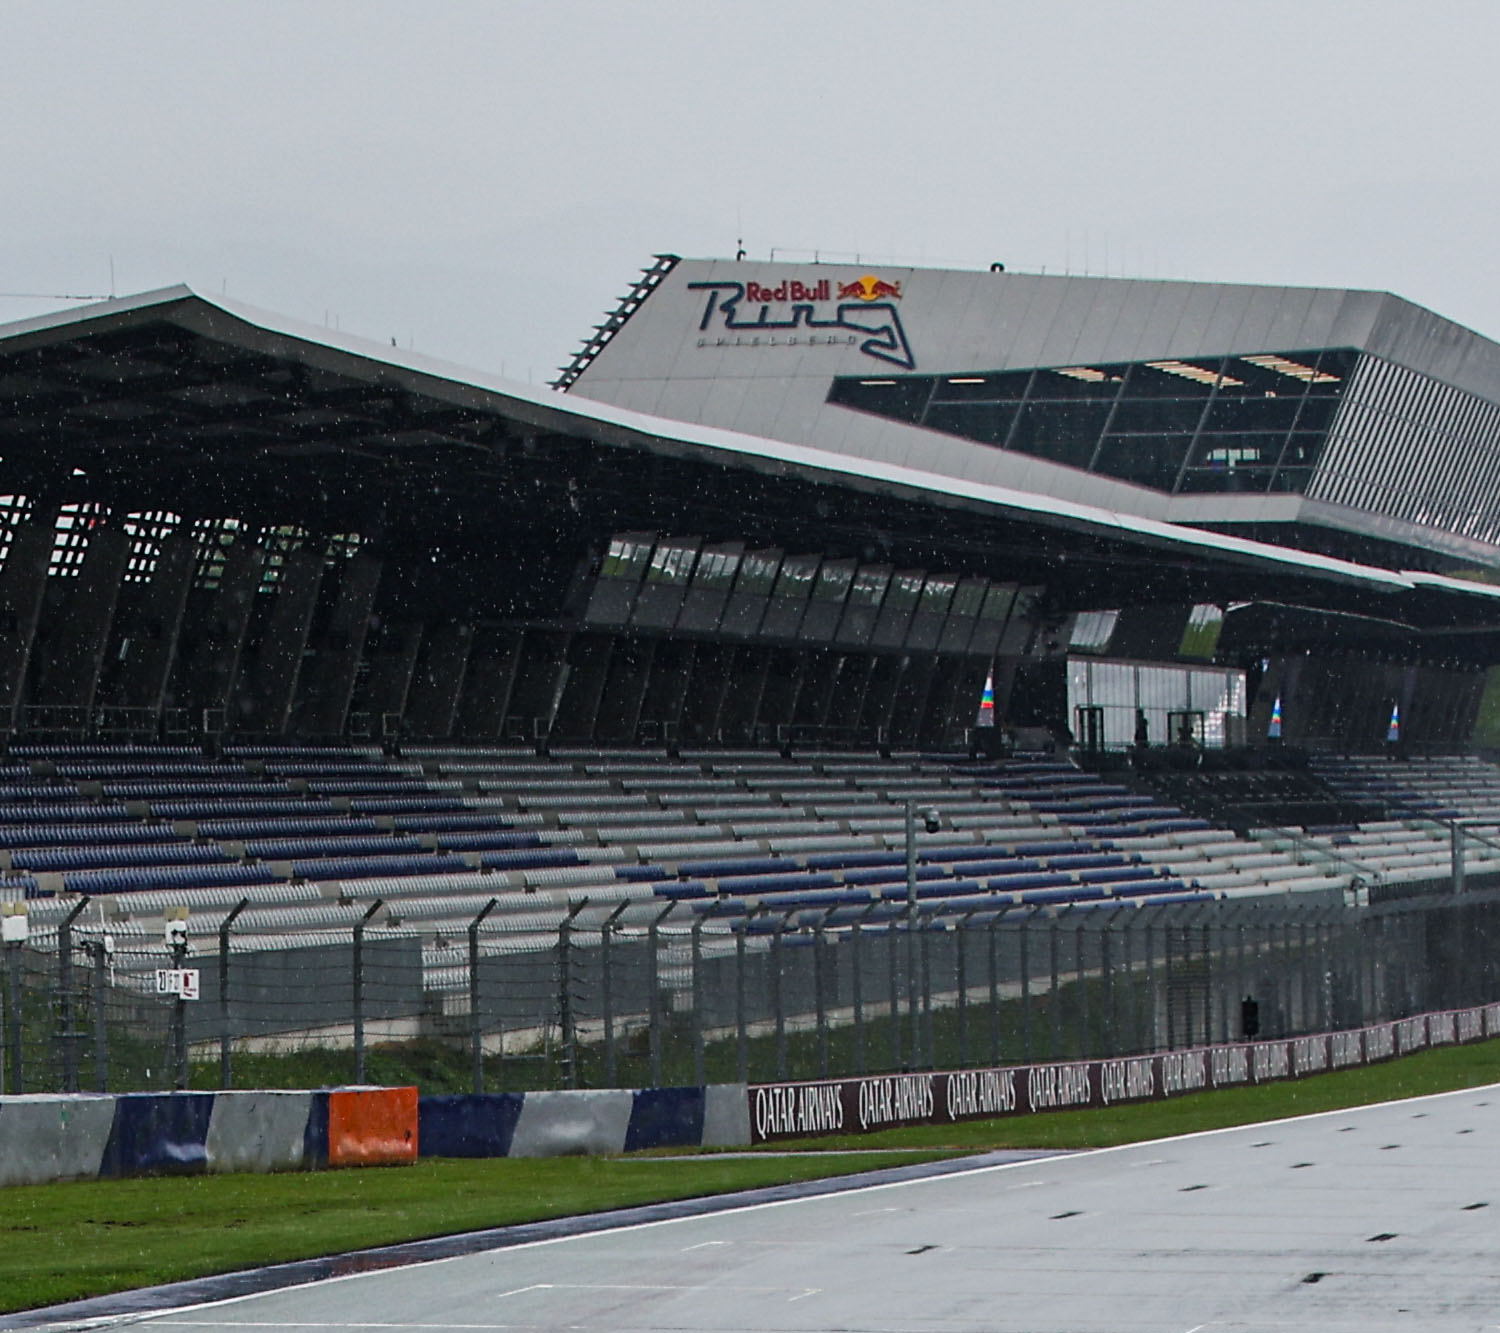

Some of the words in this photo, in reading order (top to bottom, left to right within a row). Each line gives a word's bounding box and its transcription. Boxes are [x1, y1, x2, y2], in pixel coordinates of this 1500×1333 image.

[747, 280, 788, 302] Red
[790, 280, 829, 301] Bull
[756, 1088, 795, 1140] QATAR
[797, 1084, 844, 1132] AIRWAYS
[859, 1078, 893, 1129] QATAR
[894, 1074, 934, 1120] AIRWAYS
[947, 1072, 978, 1120] QATAR
[978, 1070, 1016, 1114] AIRWAYS
